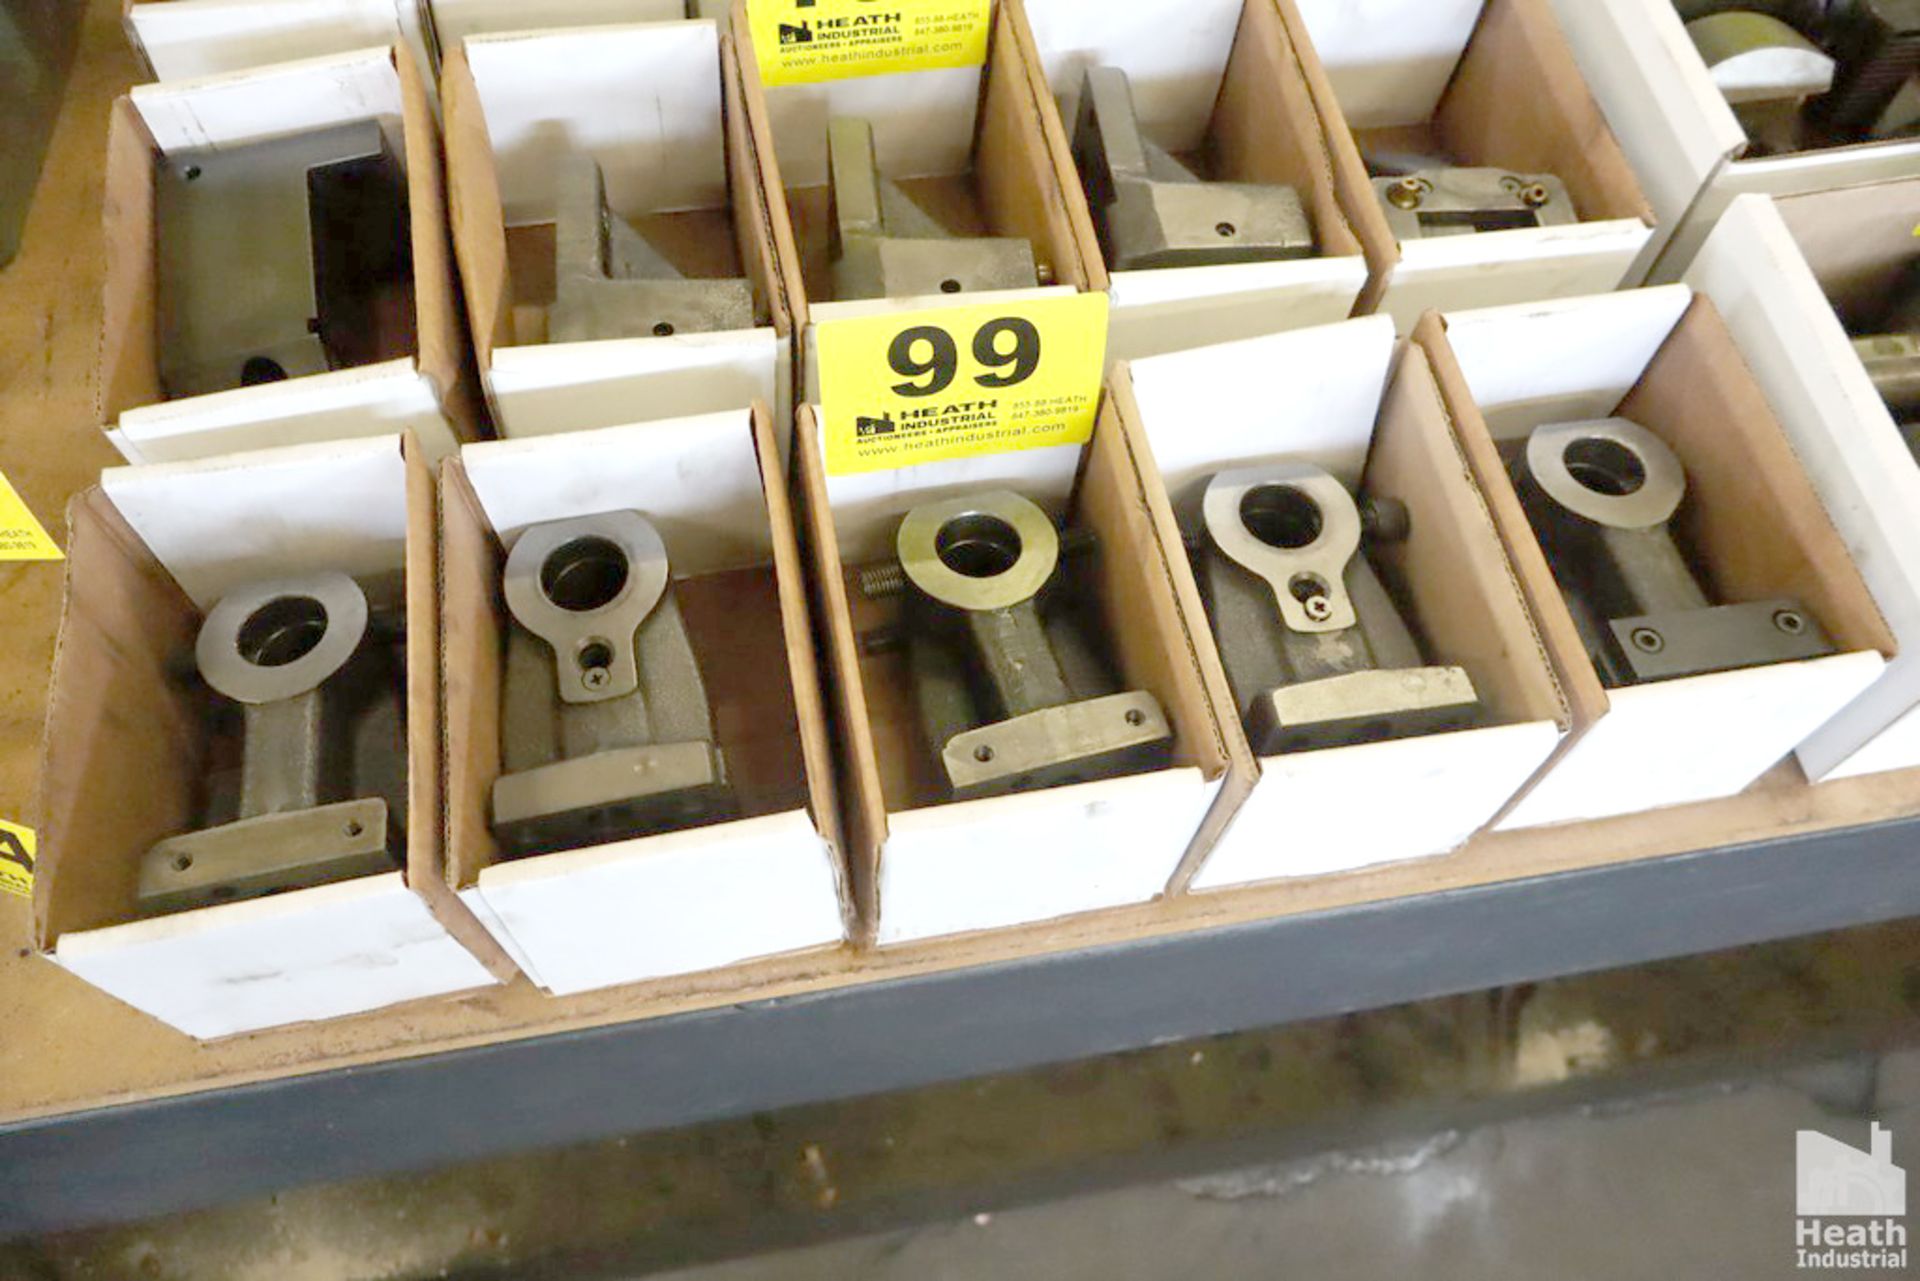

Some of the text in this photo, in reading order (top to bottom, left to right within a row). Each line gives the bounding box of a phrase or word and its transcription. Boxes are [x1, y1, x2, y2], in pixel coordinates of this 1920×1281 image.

[816, 12, 901, 29] HEATH
[780, 35, 903, 53] AUCTIONEERS APPRAISERS
[817, 26, 900, 41] INDUSTRIAL
[781, 42, 963, 68] www.heathindustrial.com
[887, 316, 1041, 397] 99
[900, 399, 998, 420] HEATH
[901, 412, 996, 430] INDUSTRIAL
[856, 421, 998, 444] AUCTIONEERS APPRAISERS
[858, 422, 1066, 457] www.heathindustrial.com
